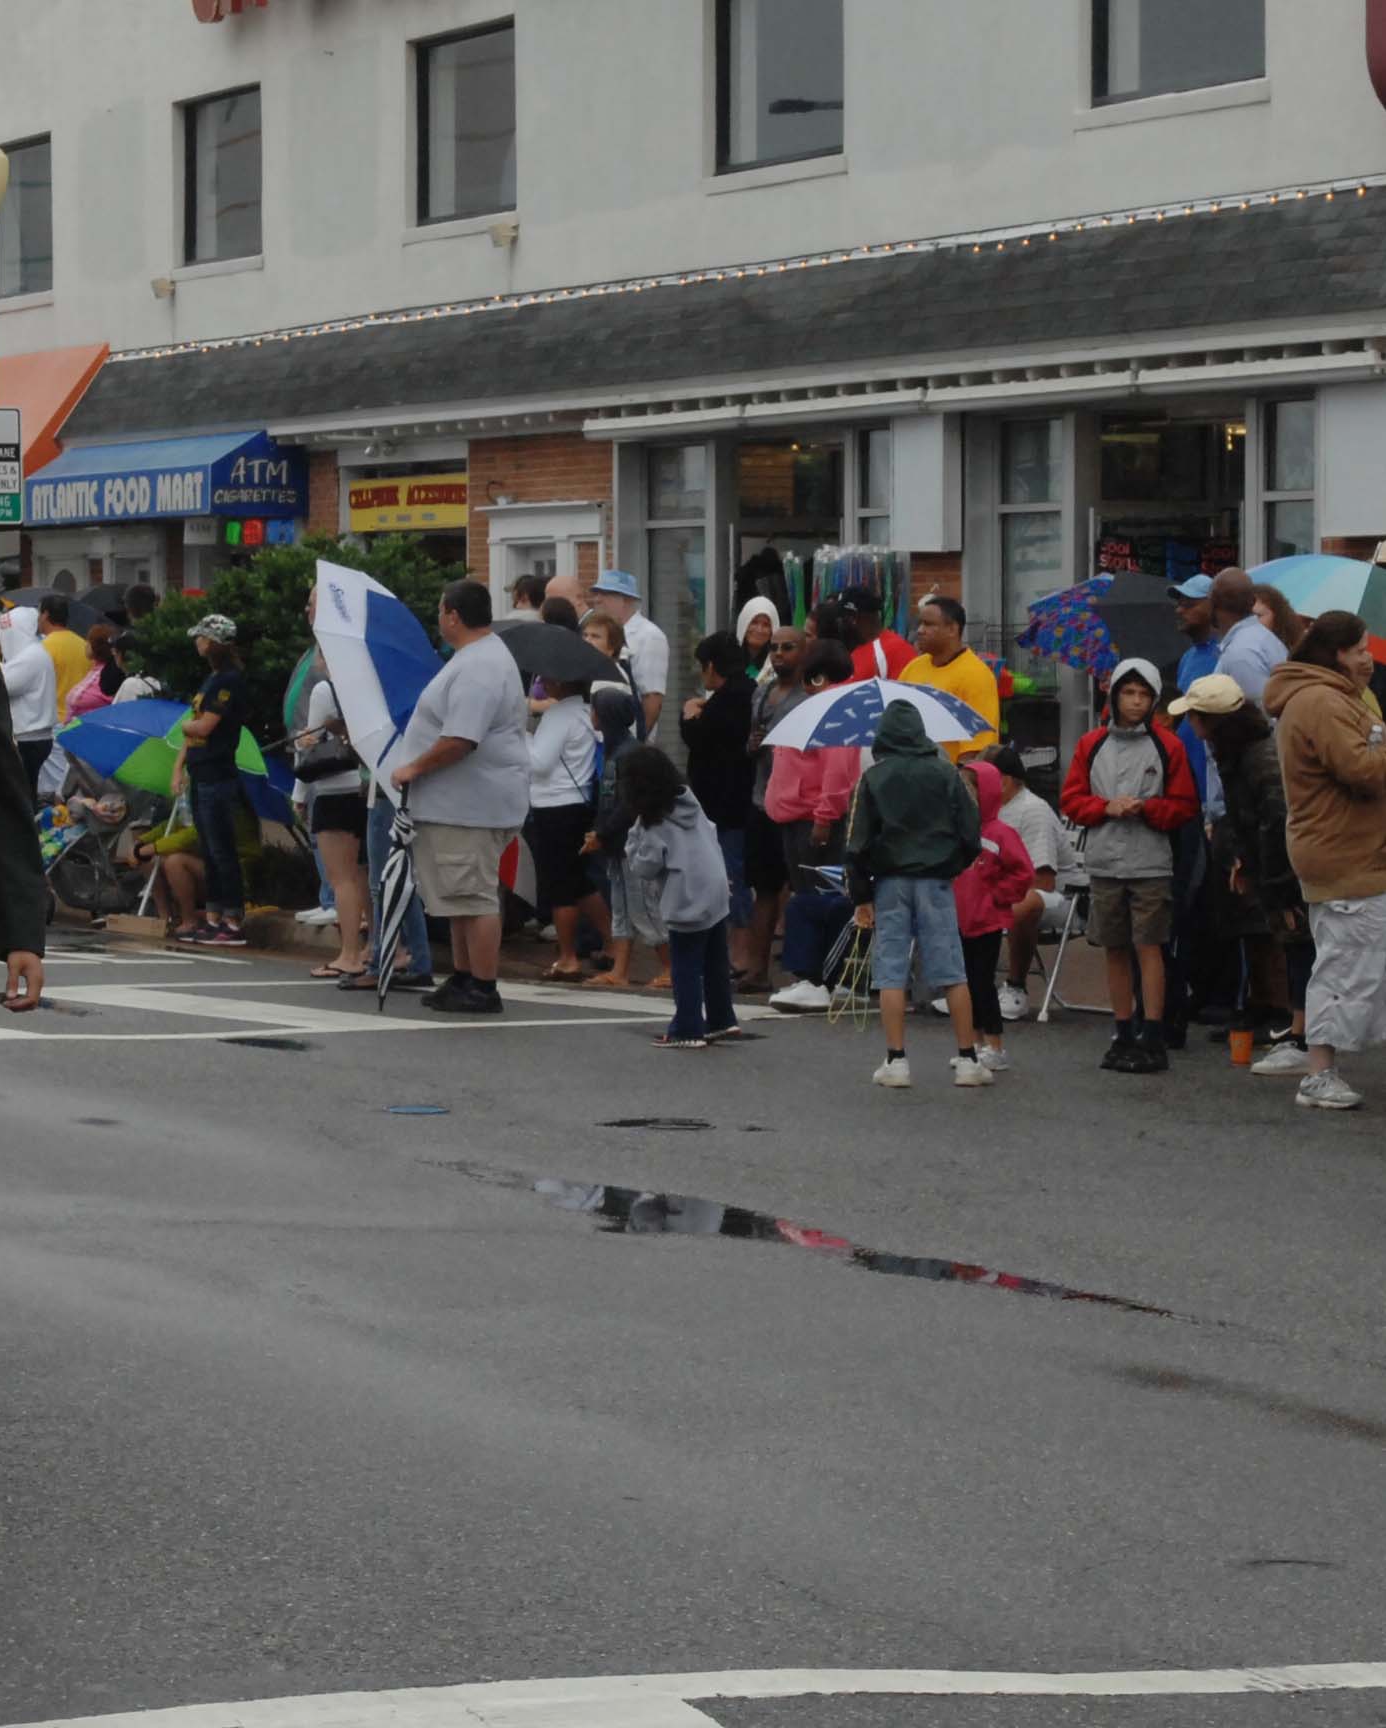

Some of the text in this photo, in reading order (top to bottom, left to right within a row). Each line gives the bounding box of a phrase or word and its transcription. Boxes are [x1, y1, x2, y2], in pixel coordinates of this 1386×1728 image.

[10, 465, 17, 475] &
[230, 455, 289, 485] ATM
[32, 471, 203, 520] ATLANTIC FOOD MART
[213, 487, 298, 505] CIGARETTES
